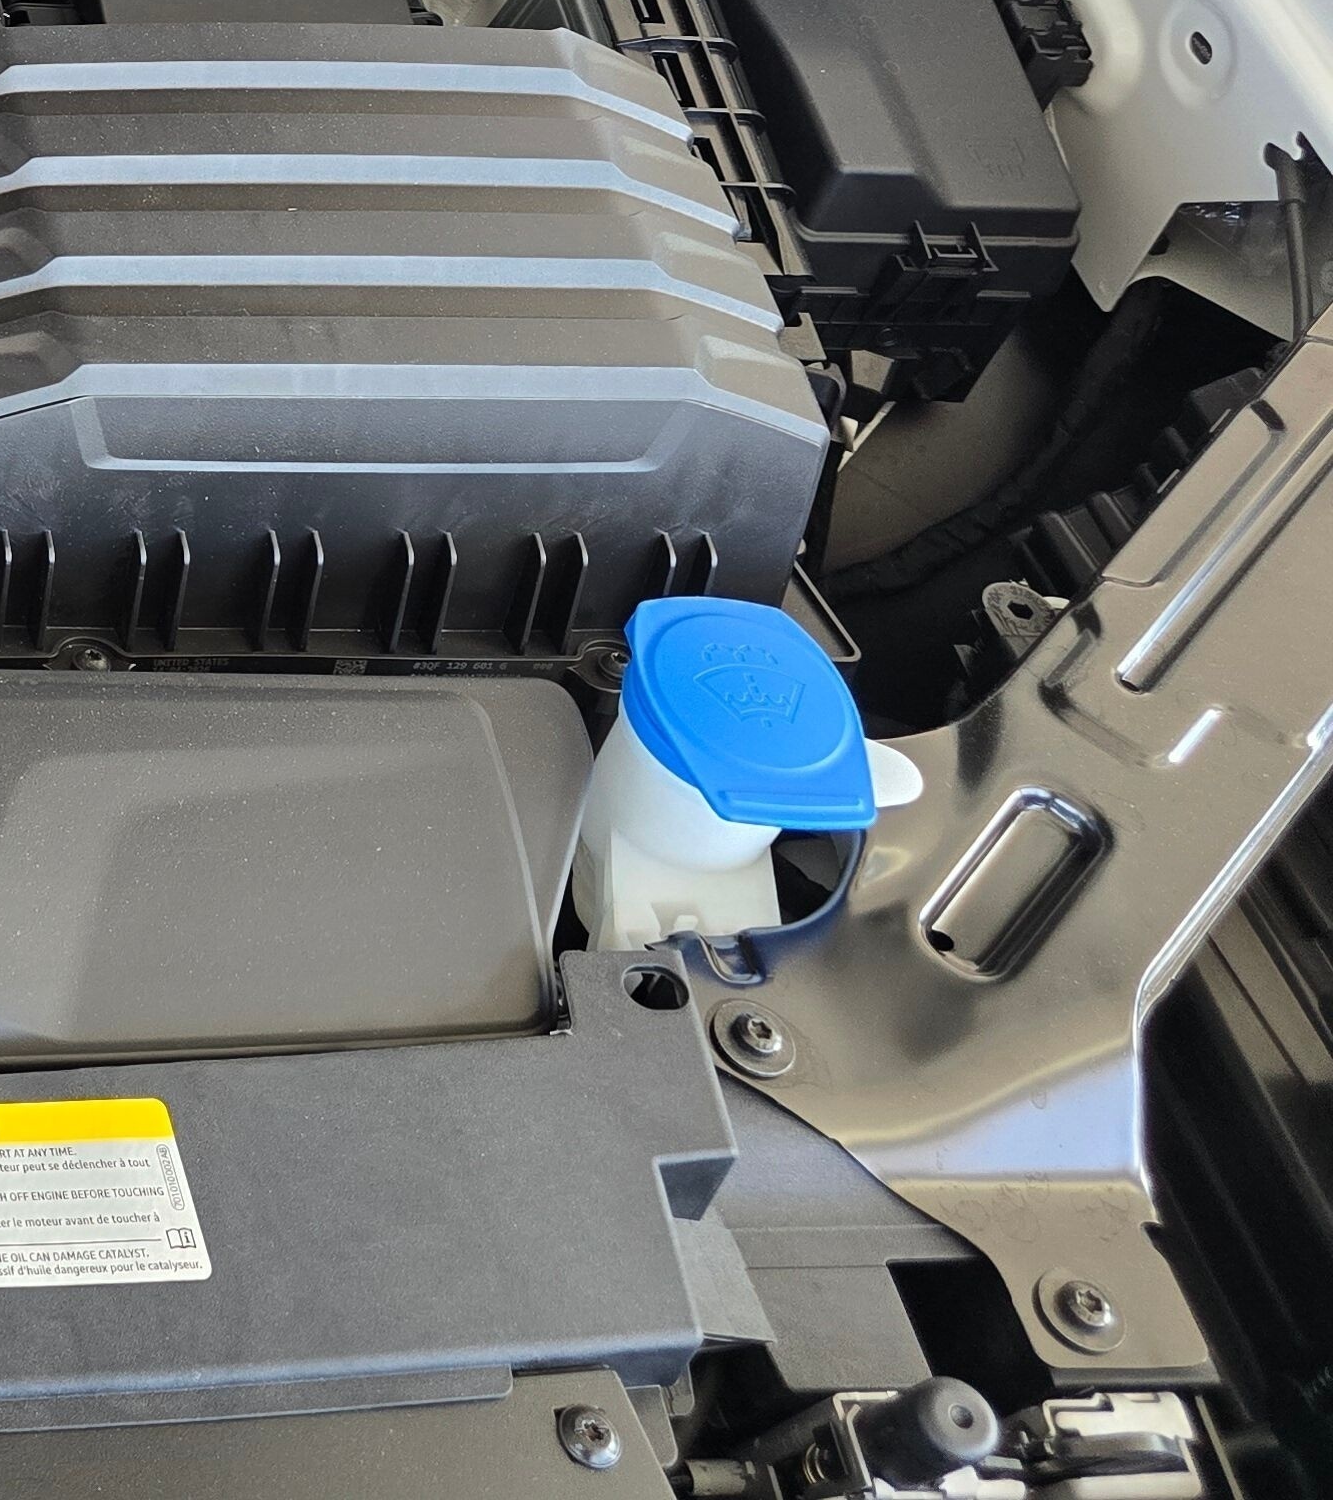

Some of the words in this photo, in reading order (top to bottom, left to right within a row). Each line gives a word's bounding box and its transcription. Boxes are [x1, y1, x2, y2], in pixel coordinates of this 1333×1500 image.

[13, 1148, 25, 1158] AT
[27, 1147, 47, 1158] ANY
[9, 1191, 29, 1202] OFF
[30, 1190, 69, 1201] ENGINE
[70, 1188, 111, 1200] BEFORE
[110, 1186, 165, 1198] TOUCHING
[10, 1252, 28, 1263] OIL
[28, 1251, 51, 1262] CAN
[52, 1249, 97, 1262] DAMAGE
[17, 1264, 52, 1276] d'huile
[53, 1264, 108, 1277] dangereux
[109, 1263, 134, 1275] pour
[134, 1260, 146, 1271] le
[147, 1259, 203, 1272] catalyseur.
